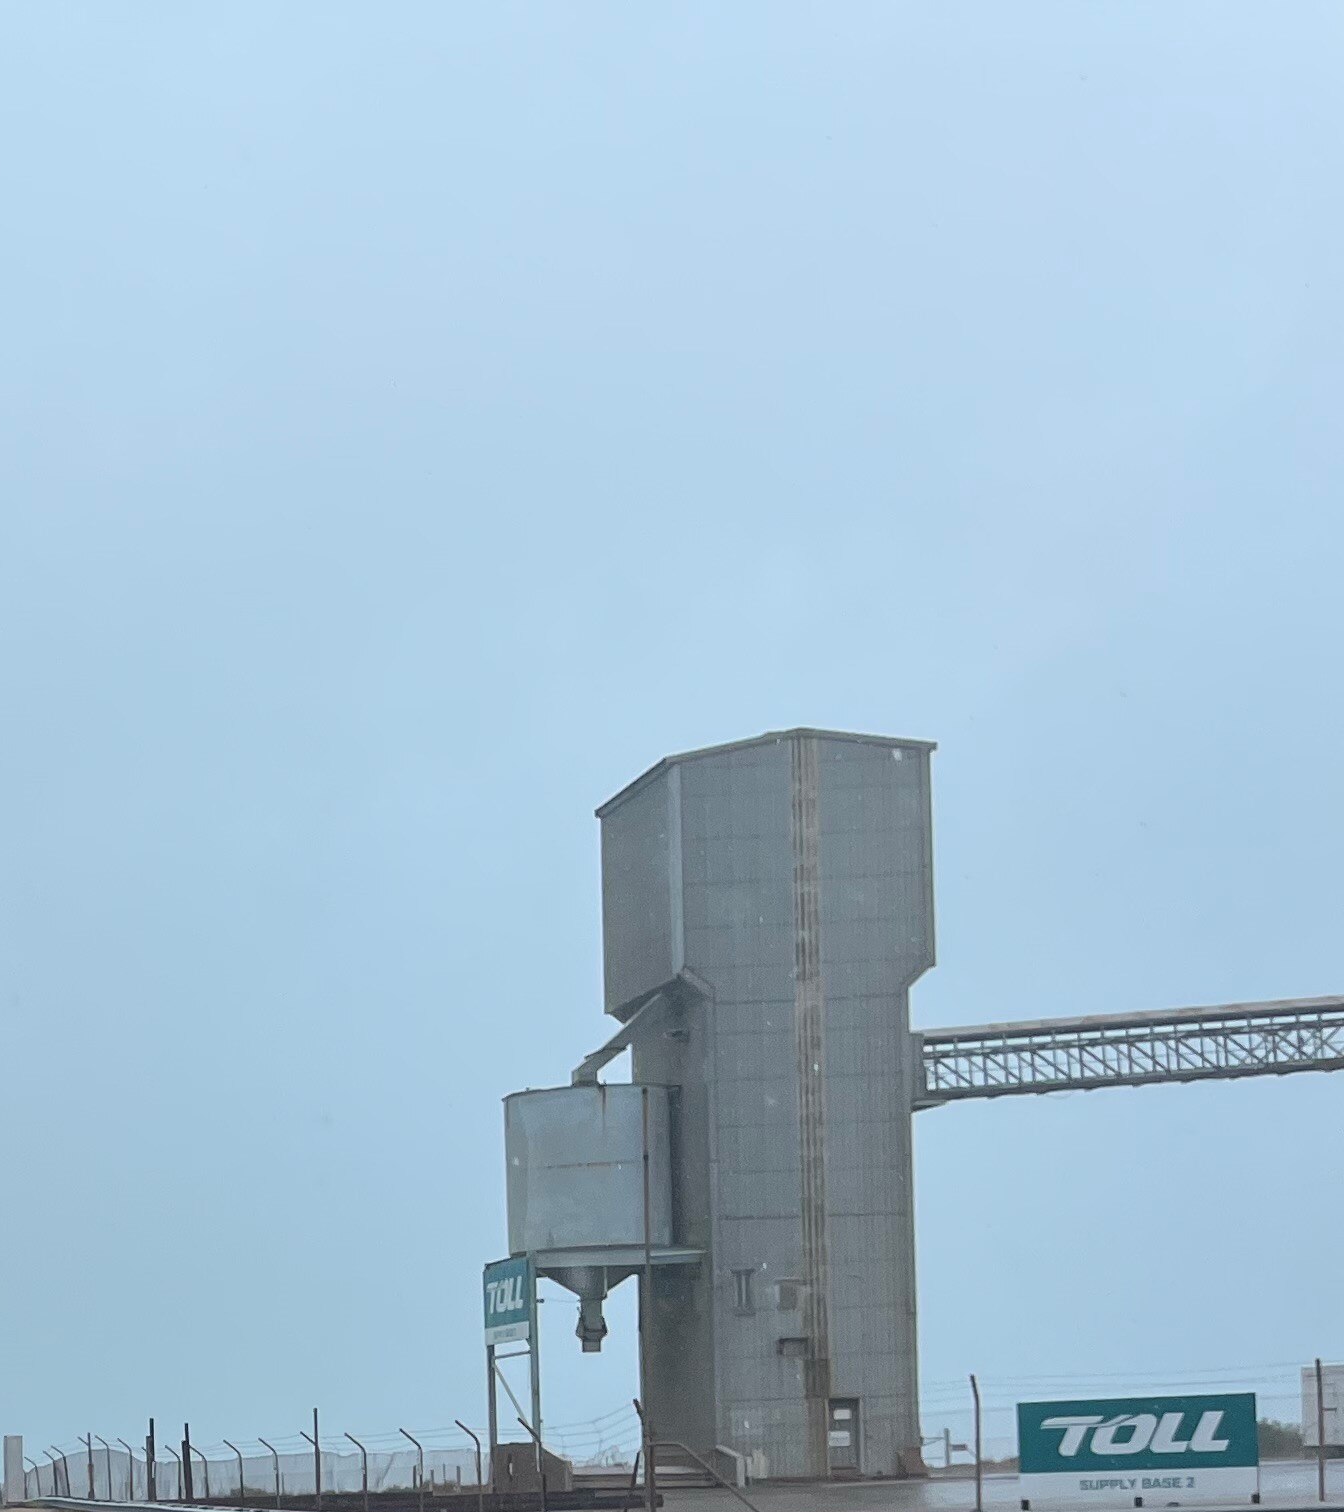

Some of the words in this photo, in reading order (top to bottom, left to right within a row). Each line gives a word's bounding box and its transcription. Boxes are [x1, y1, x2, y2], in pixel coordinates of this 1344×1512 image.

[486, 1275, 524, 1314] TOLL
[1040, 1410, 1230, 1457] TOLL
[1079, 1478, 1137, 1490] SUPPLY
[1141, 1477, 1182, 1489] BASE
